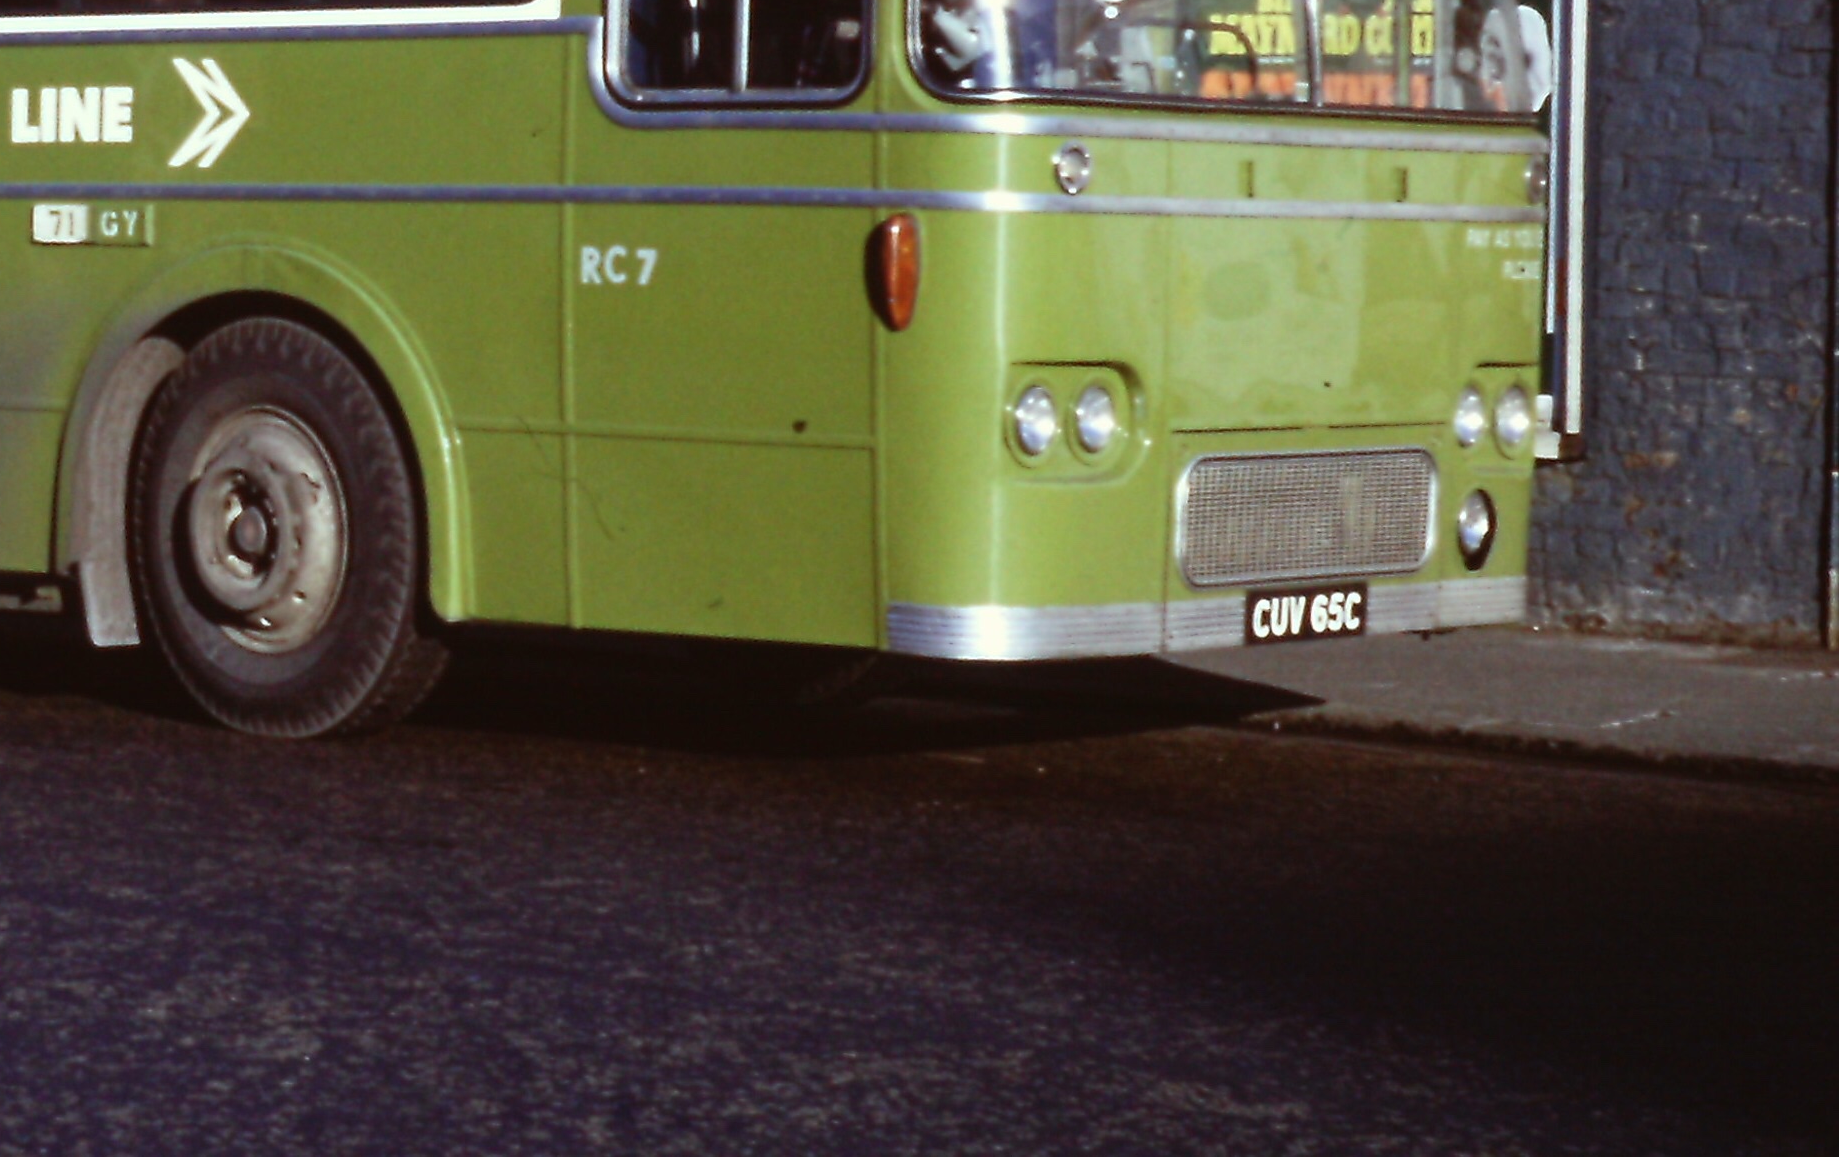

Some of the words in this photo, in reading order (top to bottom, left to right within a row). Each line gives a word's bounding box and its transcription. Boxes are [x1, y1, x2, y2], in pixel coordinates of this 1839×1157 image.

[10, 86, 134, 143] LINE
[99, 209, 139, 237] GY
[581, 245, 628, 284] RC
[636, 248, 659, 285] 7
[1252, 595, 1307, 639] CUV
[1310, 591, 1362, 634] 65C
